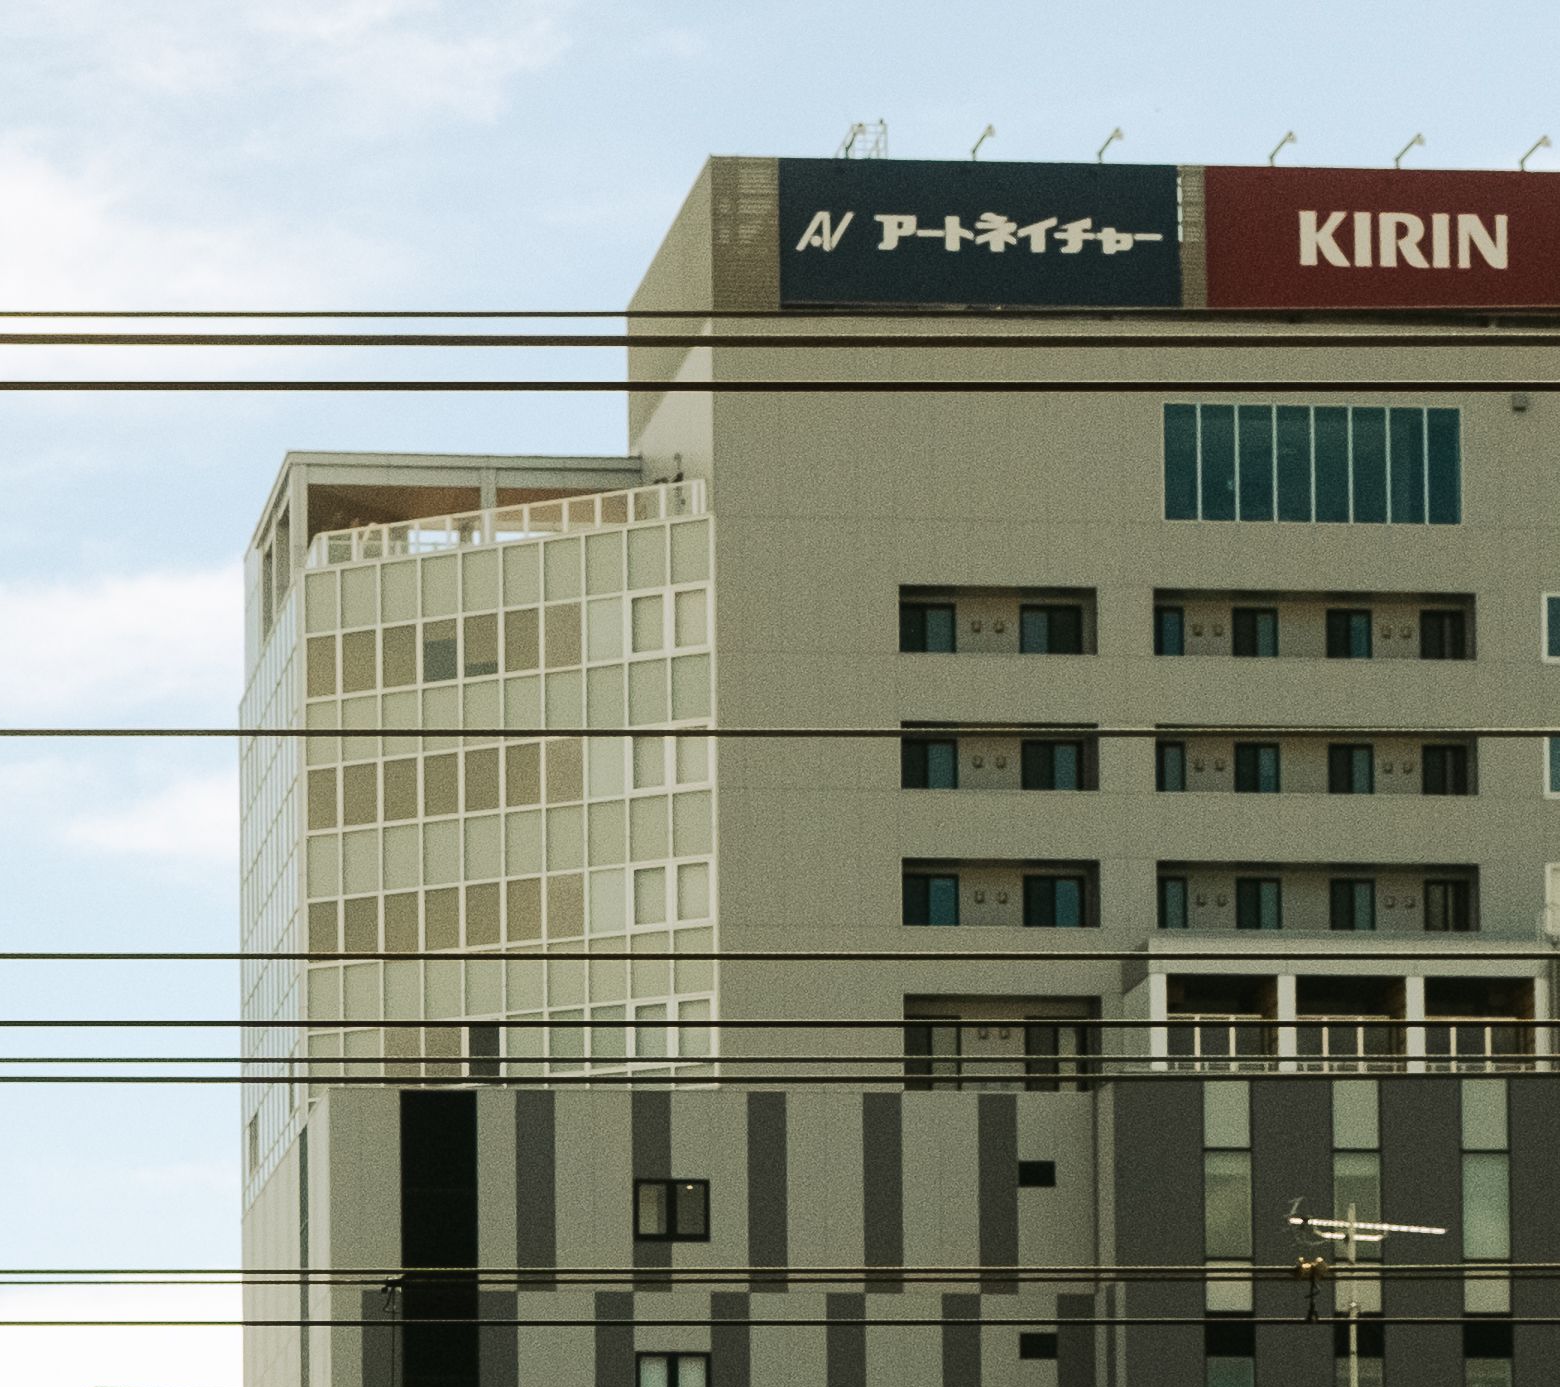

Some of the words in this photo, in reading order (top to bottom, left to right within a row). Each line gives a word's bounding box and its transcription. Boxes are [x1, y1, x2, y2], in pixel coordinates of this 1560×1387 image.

[873, 212, 1163, 255] アートネイチャー
[1298, 210, 1509, 270] KIRIN
